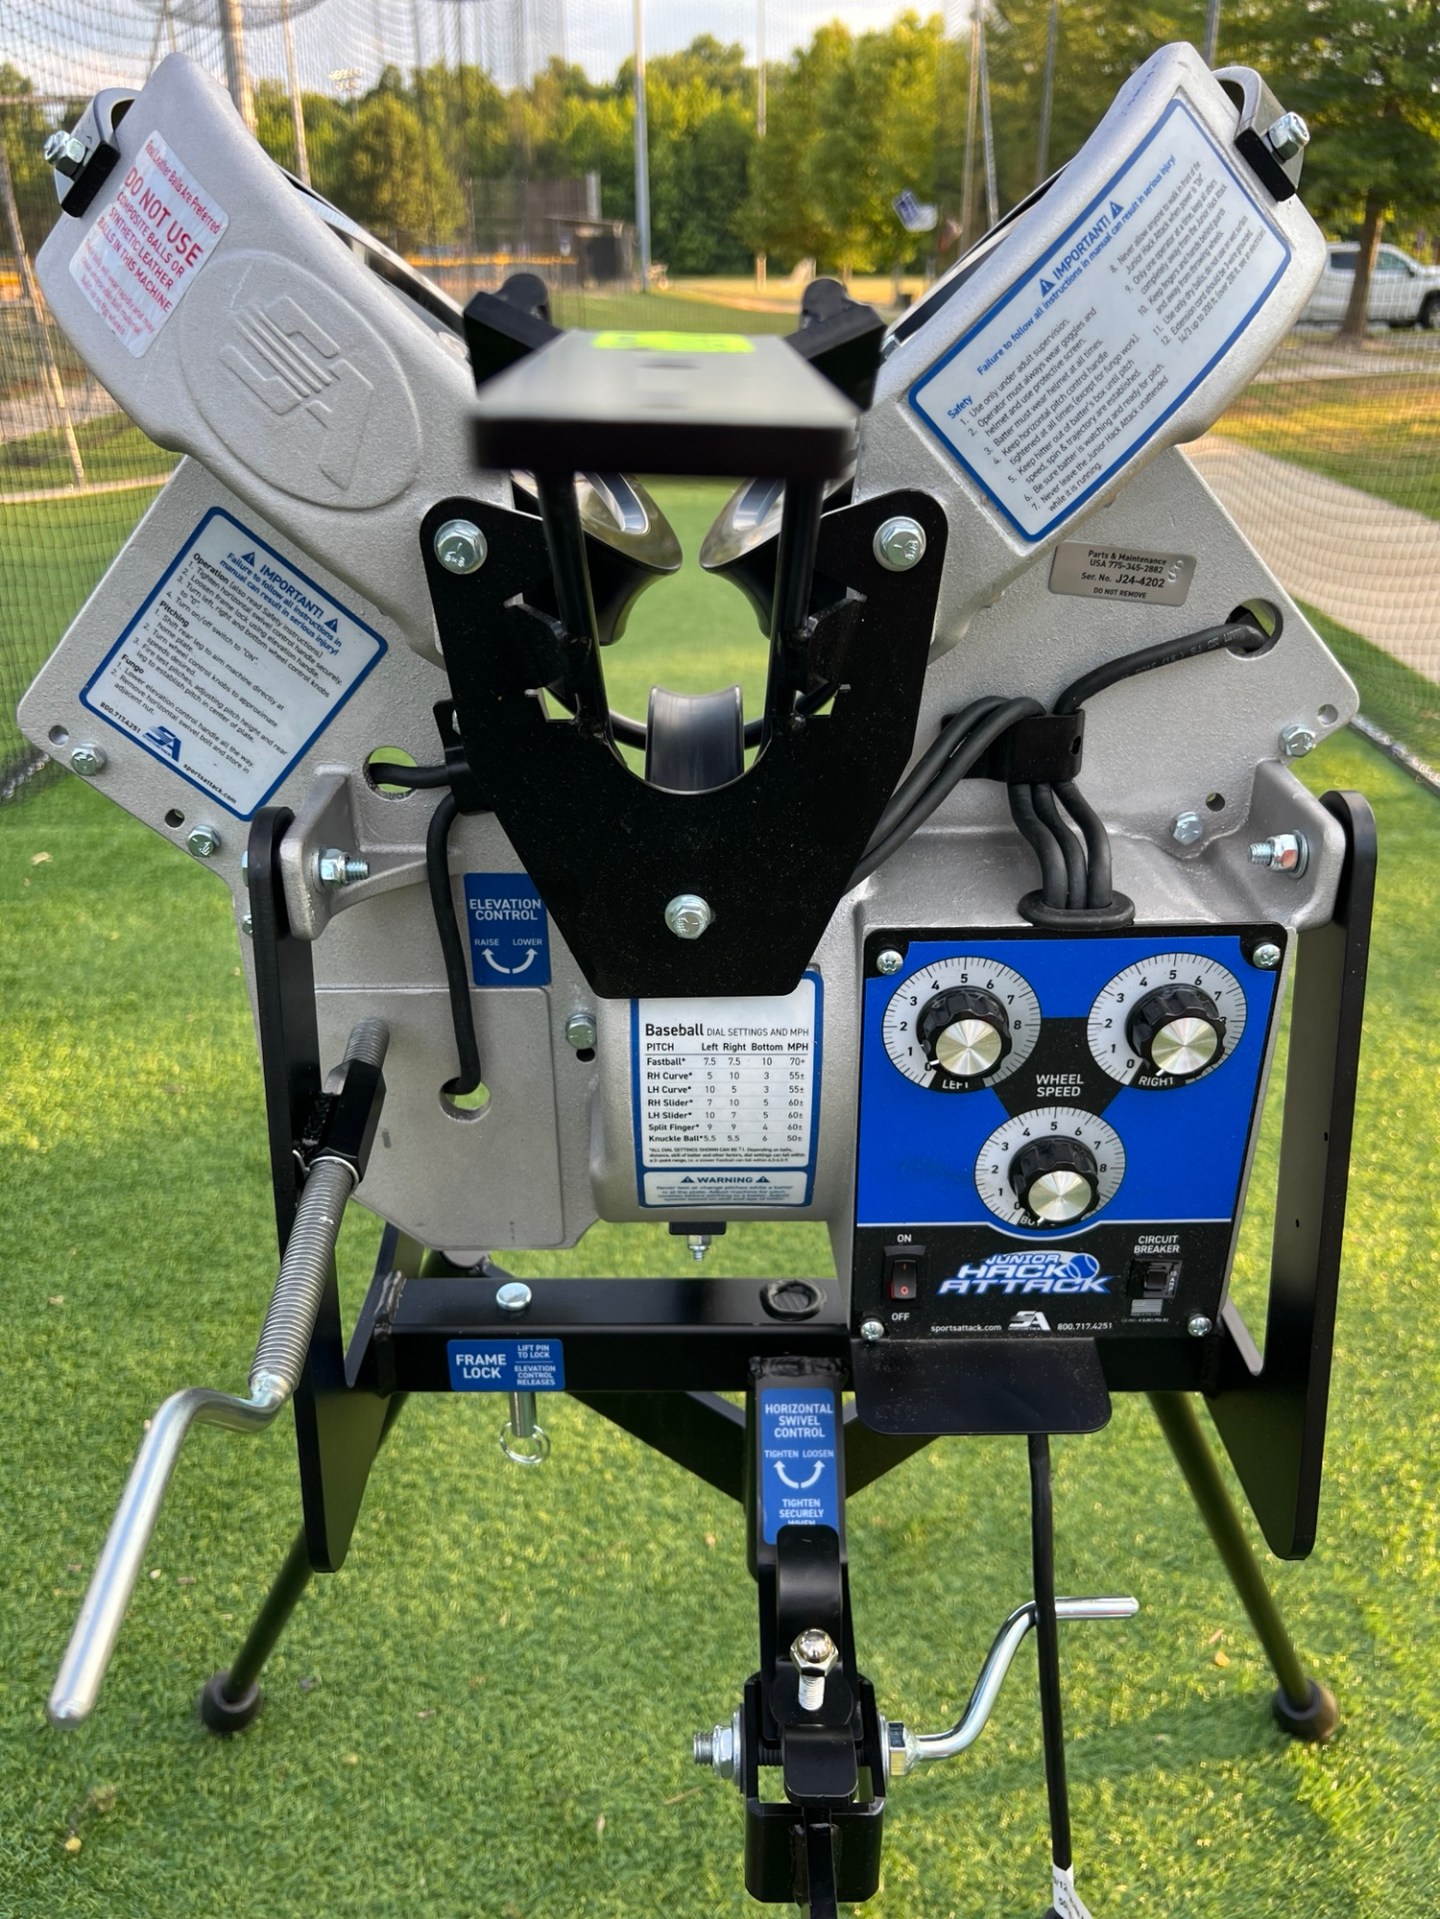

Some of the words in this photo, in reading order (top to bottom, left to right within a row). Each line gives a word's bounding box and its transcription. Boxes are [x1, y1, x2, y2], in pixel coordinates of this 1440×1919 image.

[168, 170, 183, 192] Balls
[180, 186, 192, 203] Are
[190, 196, 220, 234] Preferred
[124, 166, 143, 196] DO
[139, 188, 171, 228] NOT
[167, 220, 202, 267] USE
[116, 191, 150, 236] COMPOSITE
[146, 232, 172, 263] BALLS
[171, 260, 184, 277] OR
[109, 207, 140, 251] SYNTHETIC
[138, 246, 173, 290] LEATHER
[1052, 215, 1110, 280] IMPORTANT!
[97, 216, 116, 243] BALLS
[113, 239, 122, 252] IN
[120, 249, 136, 271] THIS
[134, 267, 172, 312] MACHINE
[947, 396, 972, 418] Safety
[1088, 550, 1108, 558] Parts
[1118, 553, 1166, 565] Maintenance
[193, 553, 228, 584] Operation
[1090, 559, 1106, 567] USA
[1108, 560, 1163, 573] 775-345-2882
[1081, 572, 1096, 580] Ser.
[1115, 574, 1165, 587] J24-4202
[260, 564, 324, 618] IMPORTANT!
[1119, 590, 1146, 598] REMOVE
[227, 552, 252, 575] Failure
[253, 573, 260, 582] to
[261, 580, 283, 599] follow
[283, 598, 294, 608] all
[293, 605, 334, 640] instructions
[334, 638, 341, 647] in
[159, 600, 189, 627] Pitching
[121, 654, 144, 674] Fungo
[183, 764, 236, 803] sportsattack.com
[470, 899, 541, 909] ELEVATION
[475, 910, 538, 920] CONTROL
[960, 974, 968, 983] 5
[1169, 970, 1177, 980] 5
[987, 980, 994, 989] 6
[1140, 977, 1148, 986] 4
[1195, 976, 1202, 985] 6
[932, 981, 940, 990] 4
[1007, 995, 1015, 1004] 7
[1117, 993, 1124, 1002] 3
[1214, 991, 1222, 1001] 7
[910, 997, 918, 1006] 3
[900, 1022, 907, 1031] 2
[1014, 1020, 1021, 1029] 8
[1105, 1019, 1112, 1028] 2
[645, 1023, 704, 1037] Baseball
[707, 1028, 726, 1037] DIAL
[728, 1028, 768, 1037] SETTINGS
[770, 1028, 788, 1037] AND
[790, 1028, 809, 1036] MPH
[646, 1043, 674, 1051] PITCH
[701, 1043, 718, 1051] Left
[723, 1043, 746, 1053] Right
[908, 1047, 912, 1056] 1
[1111, 1044, 1116, 1053] 1
[704, 1058, 716, 1066] 7.5
[728, 1058, 741, 1066] 7.5
[762, 1058, 772, 1066] 10
[1127, 1059, 1135, 1068] 0
[647, 1072, 660, 1080] RH
[707, 1072, 712, 1080] 5
[730, 1072, 739, 1080] 10
[764, 1072, 769, 1080] 3
[1036, 1074, 1084, 1084] WHEEL
[1138, 1076, 1174, 1086] RIGHT
[647, 1086, 660, 1094] LH
[705, 1086, 715, 1094] 10
[731, 1086, 737, 1094] 5
[763, 1086, 769, 1094] 3
[1036, 1087, 1081, 1097] SPEED
[648, 1124, 667, 1132] Split
[707, 1124, 712, 1132] 9
[731, 1124, 736, 1132] 9
[762, 1124, 768, 1132] 4
[1050, 1122, 1058, 1131] 5
[1023, 1128, 1031, 1136] 4
[1075, 1127, 1082, 1136] 6
[1002, 1142, 1009, 1151] 3
[1094, 1141, 1101, 1150] 7
[992, 1165, 998, 1173] 2
[1100, 1164, 1107, 1172] 8
[897, 1234, 911, 1242] ON
[1138, 1235, 1178, 1244] CIRCUIT
[1134, 1245, 1180, 1254] BREAKER
[985, 1254, 1060, 1266] JUNIOR
[957, 1264, 1069, 1278] HACK
[937, 1278, 1114, 1295] ATTACK
[891, 1312, 910, 1321] OFF
[931, 1324, 1001, 1333] sportsattack.com
[1057, 1322, 1112, 1331] 800.717.4251
[456, 1354, 506, 1366] FRAME
[463, 1367, 502, 1379] LOCK
[765, 1404, 833, 1414] HORIZONTAL
[779, 1416, 820, 1425] SWIVEL
[774, 1428, 825, 1438] CONTROL
[782, 1499, 820, 1507] TIGHTEN
[779, 1509, 824, 1518] SECURELY
